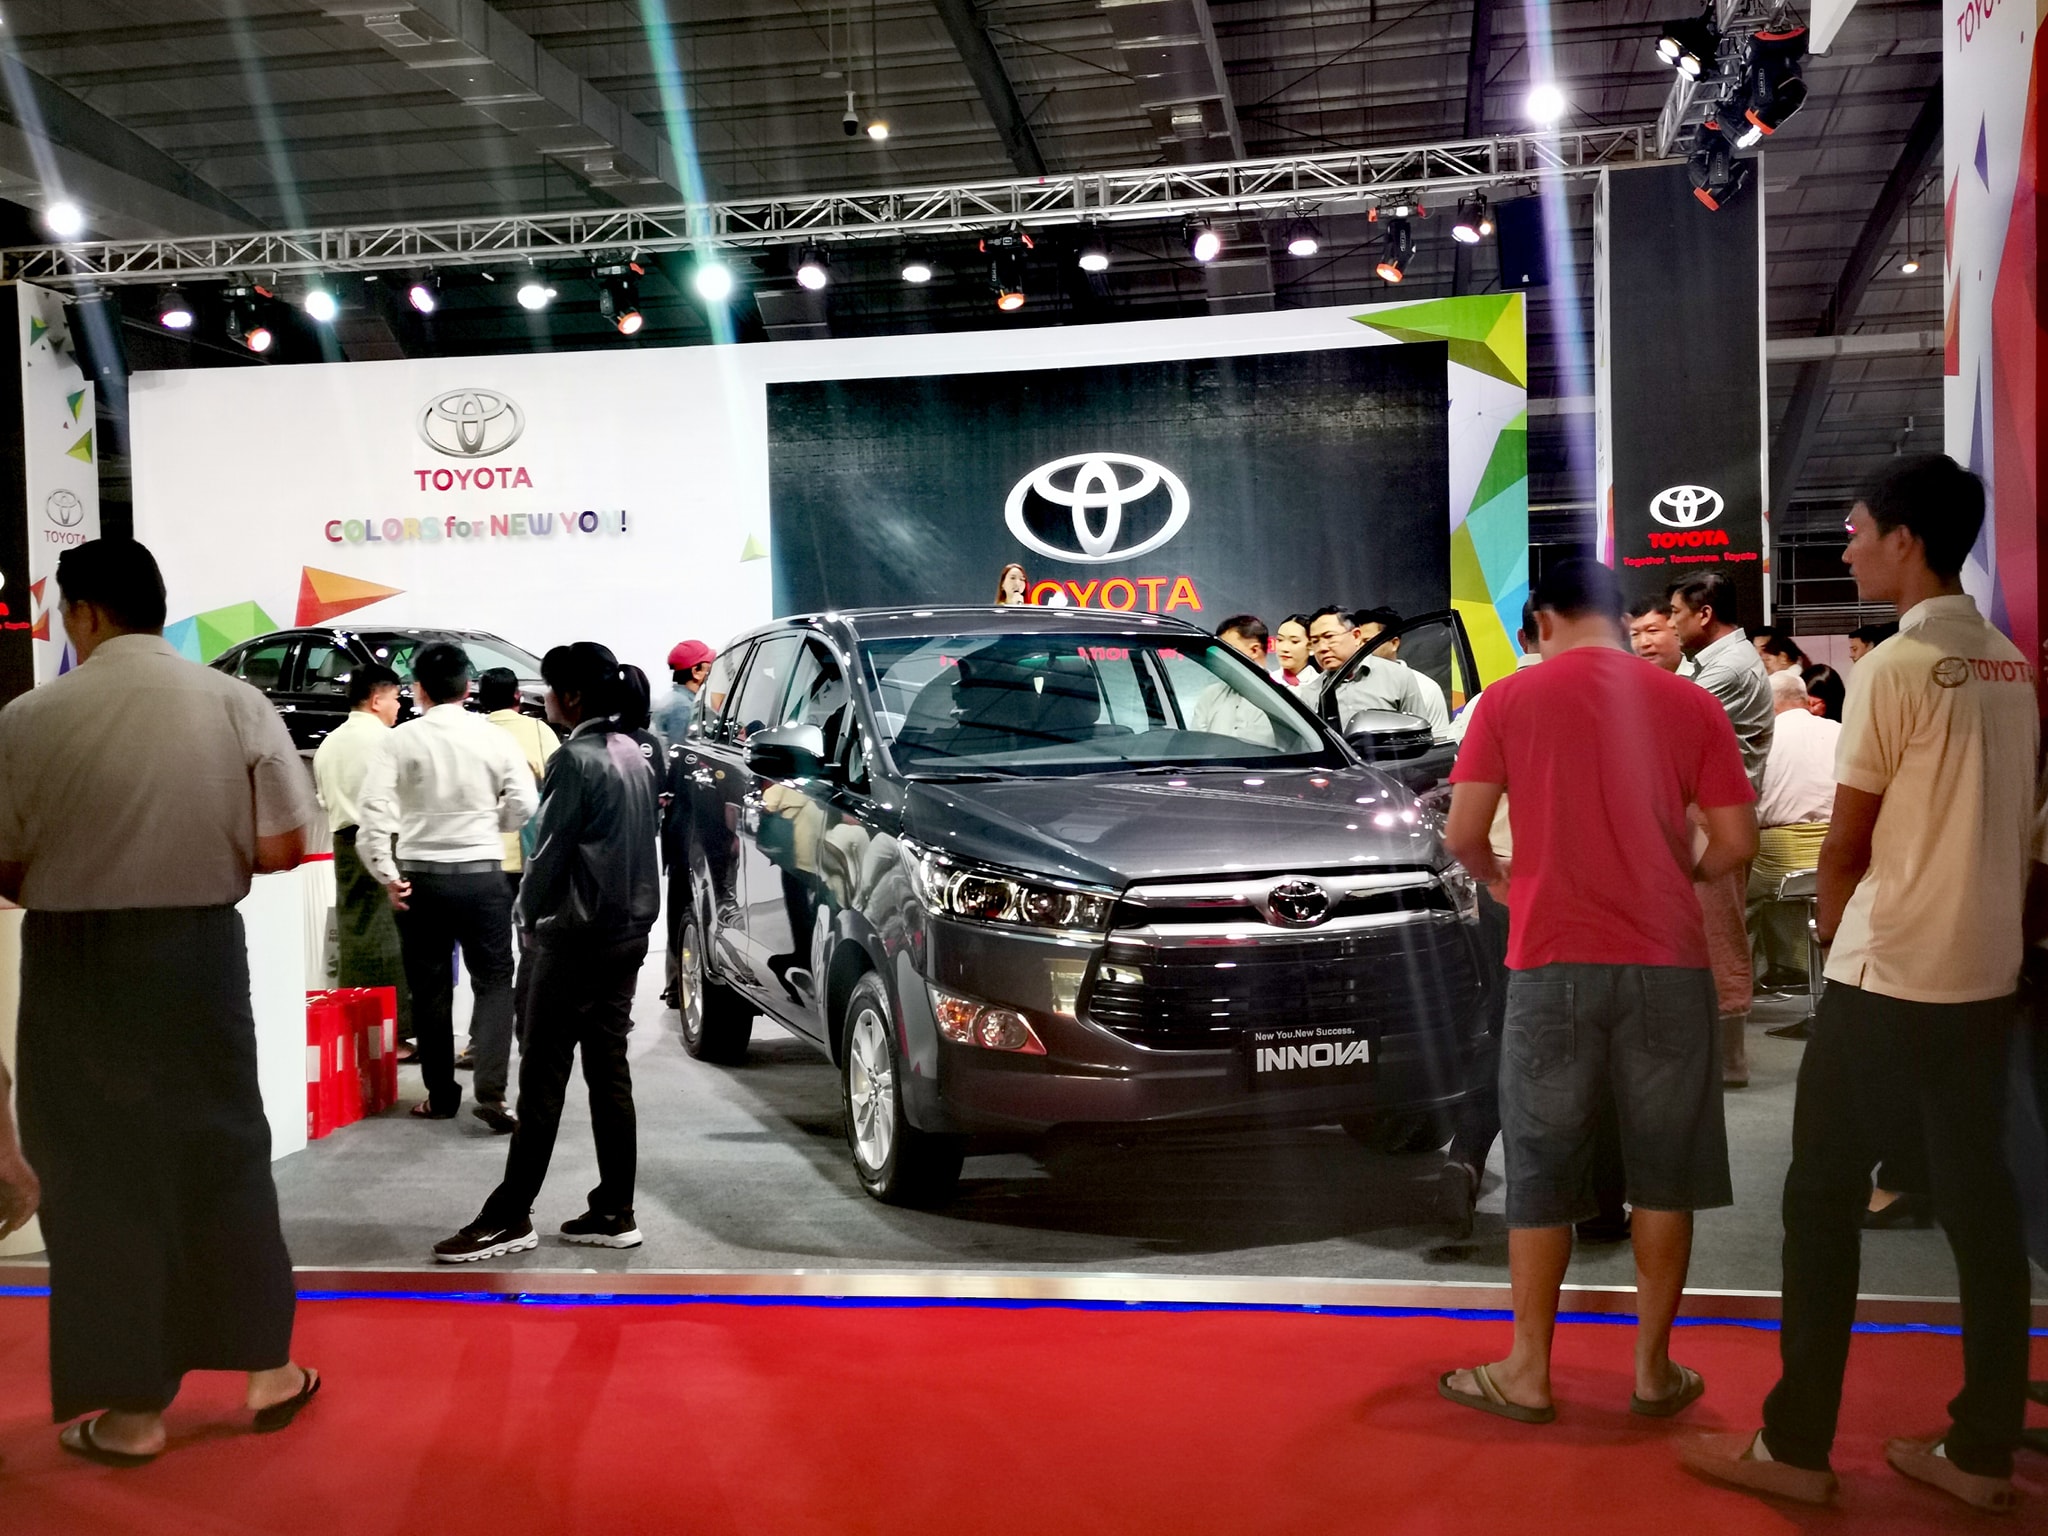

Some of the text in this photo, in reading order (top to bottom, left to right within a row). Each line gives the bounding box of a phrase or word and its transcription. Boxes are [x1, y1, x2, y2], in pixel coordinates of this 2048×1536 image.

[414, 467, 533, 491] TOYOTA
[325, 510, 627, 542] COLORS for NEW YOU!
[1648, 530, 1729, 549] TOYOTA
[1026, 576, 1203, 613] OYOTA
[1255, 1032, 1274, 1041] New
[1256, 1040, 1369, 1072] INNOVA
